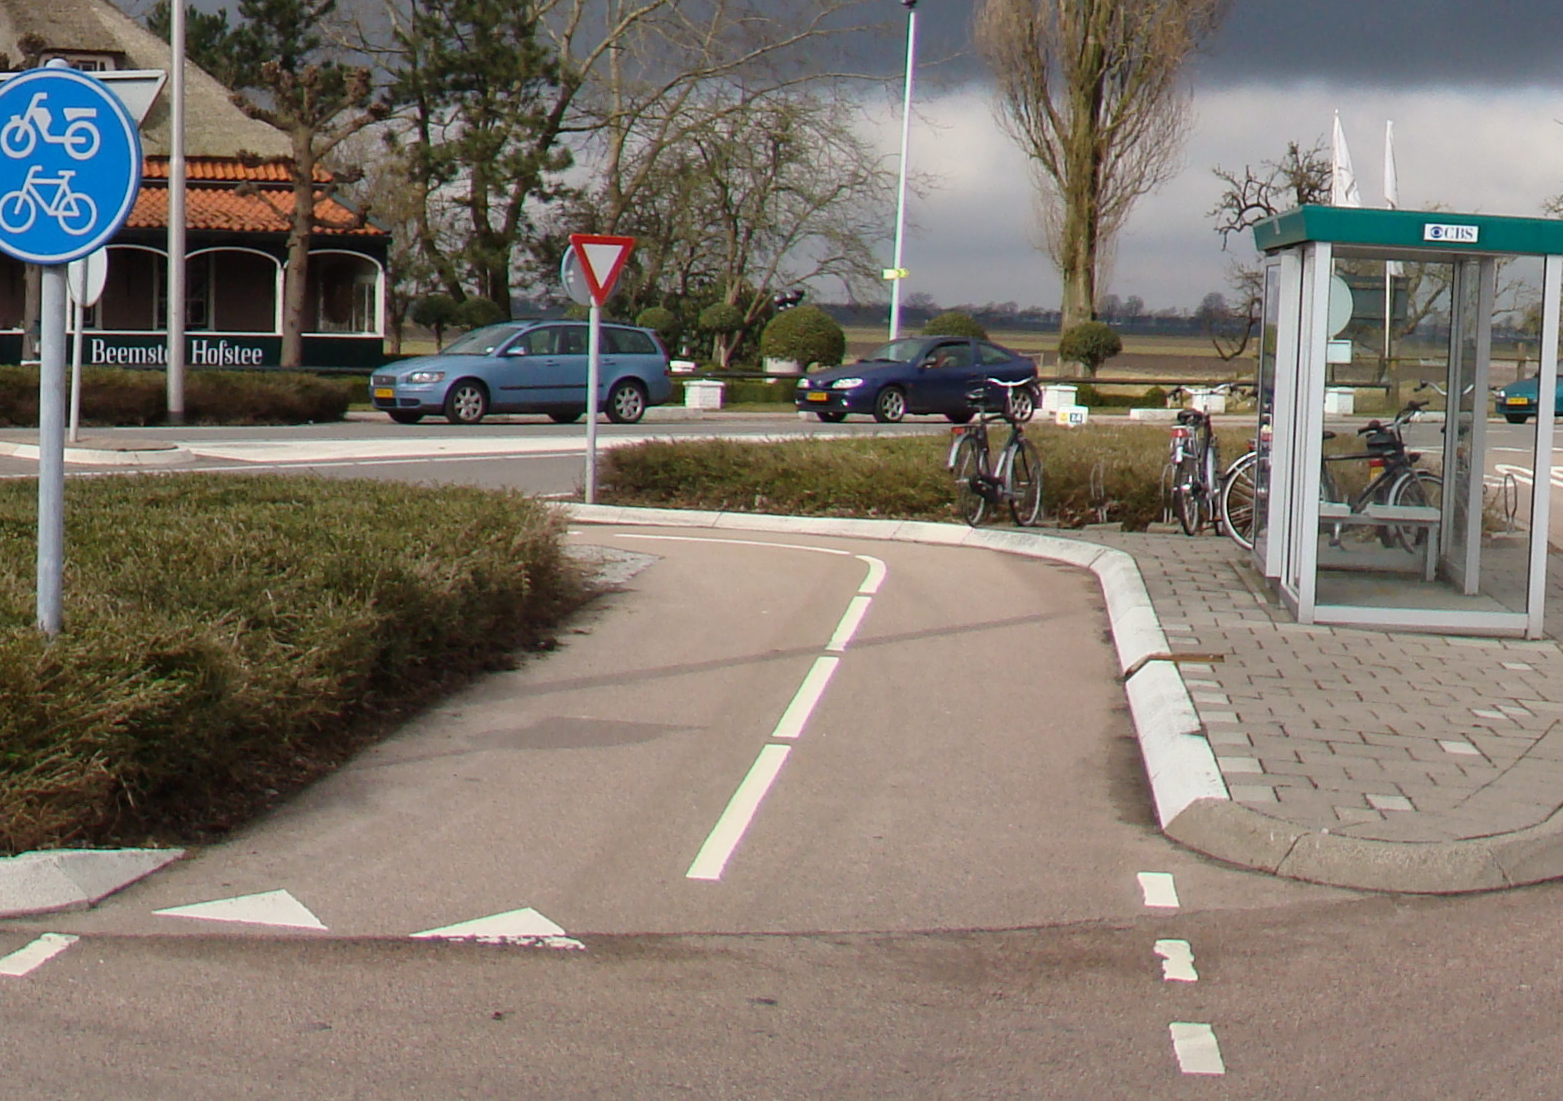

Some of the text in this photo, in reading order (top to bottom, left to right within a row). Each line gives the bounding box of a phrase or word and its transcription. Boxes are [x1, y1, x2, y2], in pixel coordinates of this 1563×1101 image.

[1444, 226, 1474, 240] CBS
[91, 338, 263, 366] Beemst Hofstee
